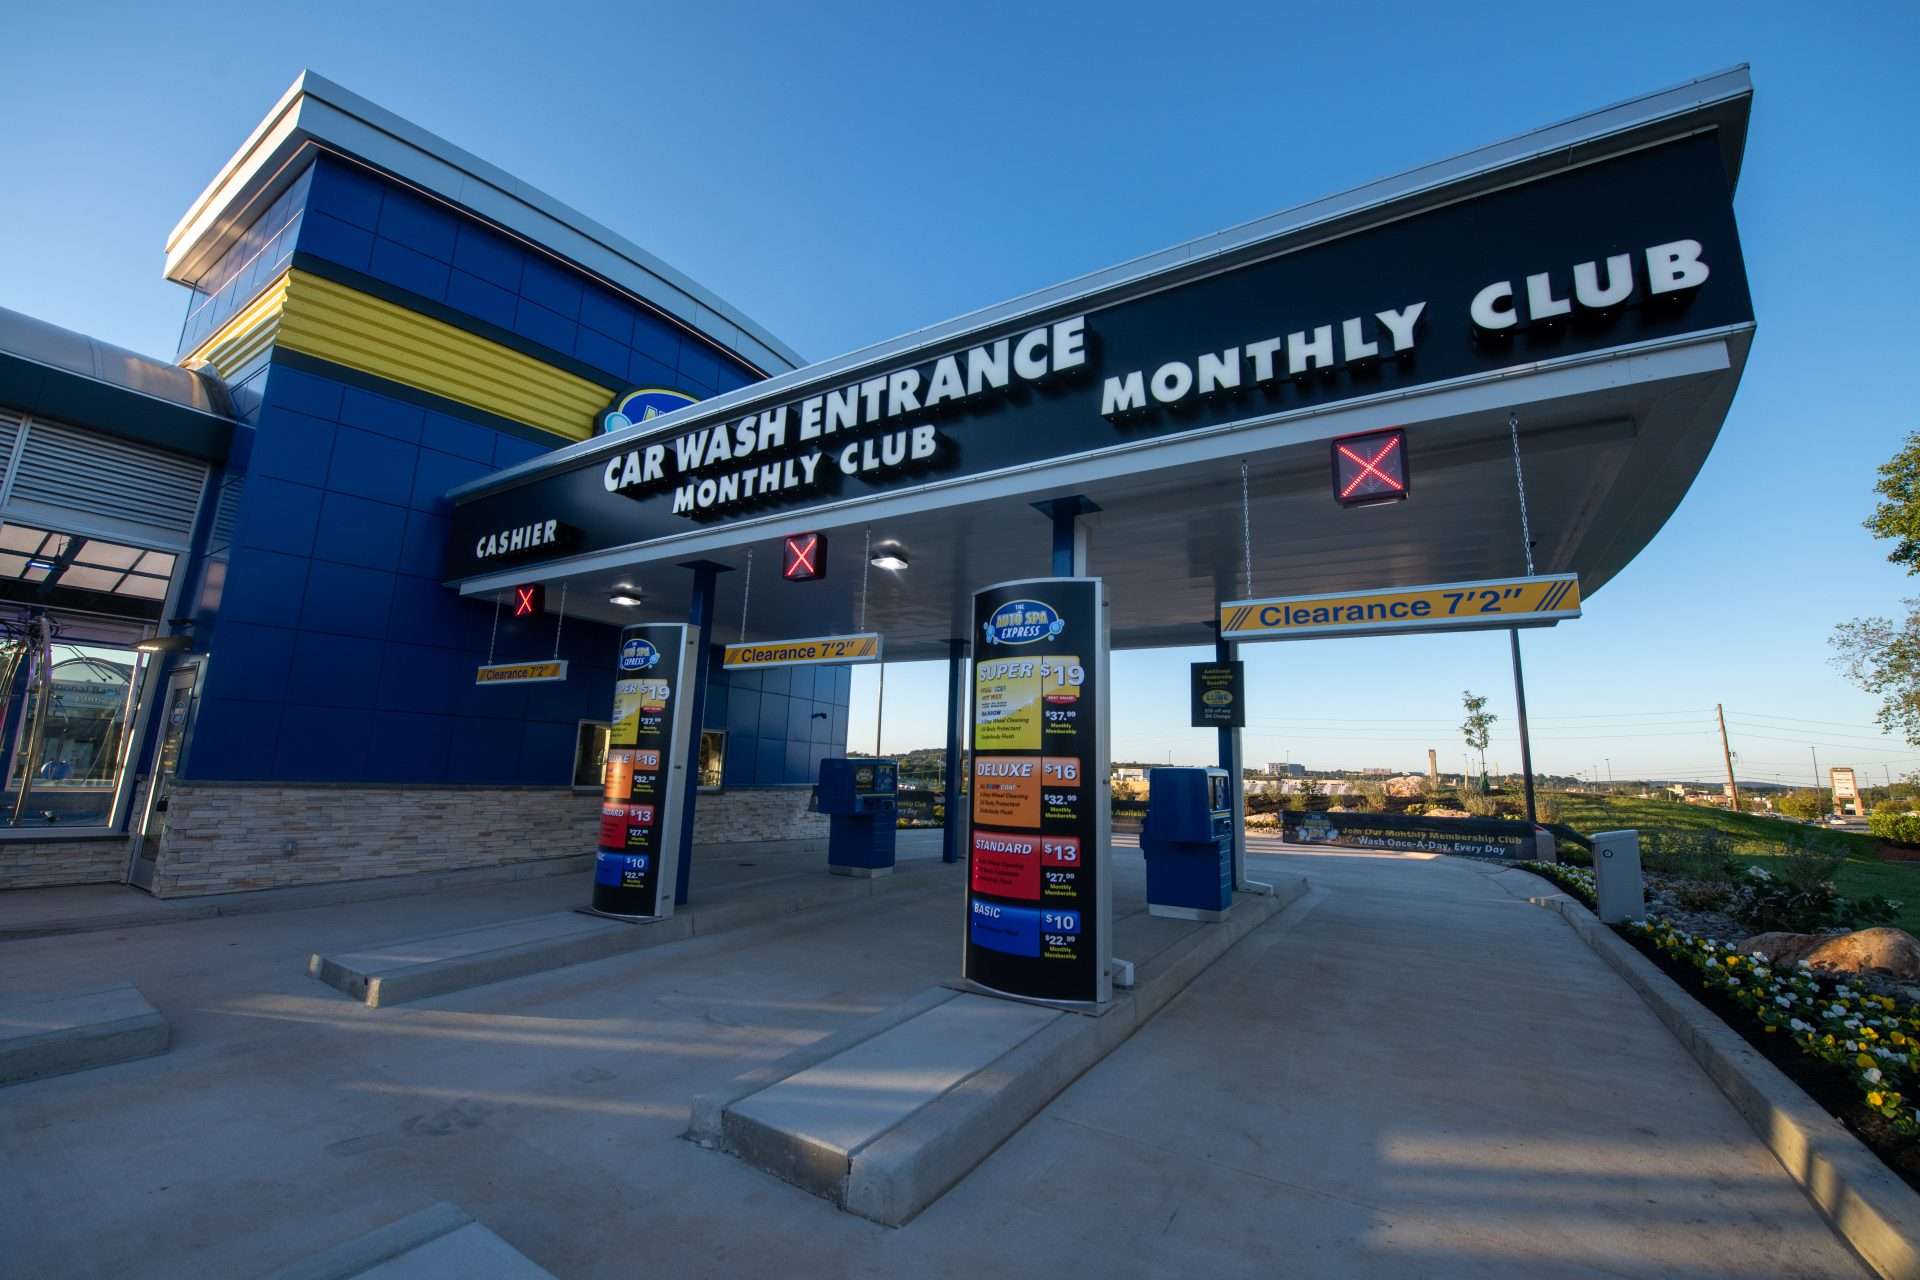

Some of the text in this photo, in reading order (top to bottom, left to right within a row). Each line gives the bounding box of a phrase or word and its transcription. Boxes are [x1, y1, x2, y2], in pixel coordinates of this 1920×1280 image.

[1101, 238, 1710, 416] MONTHLY CLUB
[603, 315, 1086, 492] CAR WASH ENTRANCE
[671, 424, 937, 515] MONTHLY CLUB
[476, 519, 557, 559] CASHIER
[1259, 587, 1525, 627] Clearance 7'2"
[1001, 626, 1041, 639] EXPRESS
[741, 647, 817, 663] Clearance
[486, 669, 528, 681] Clearance
[979, 662, 1034, 682] SUPER
[1040, 663, 1085, 687] $19
[977, 763, 1033, 777] DELUXE
[1044, 763, 1077, 780] $16
[1364, 828, 1383, 836] Our
[1385, 830, 1426, 840] Monthly
[1428, 832, 1495, 844] Membership
[1497, 835, 1523, 845] Club
[975, 839, 1033, 855] STANDARD
[1044, 843, 1077, 861] $13
[1358, 835, 1385, 846] Wash
[1454, 842, 1482, 854] Every
[1485, 844, 1505, 856] Day
[974, 903, 1001, 919] BASIC
[1046, 914, 1074, 930] $10
